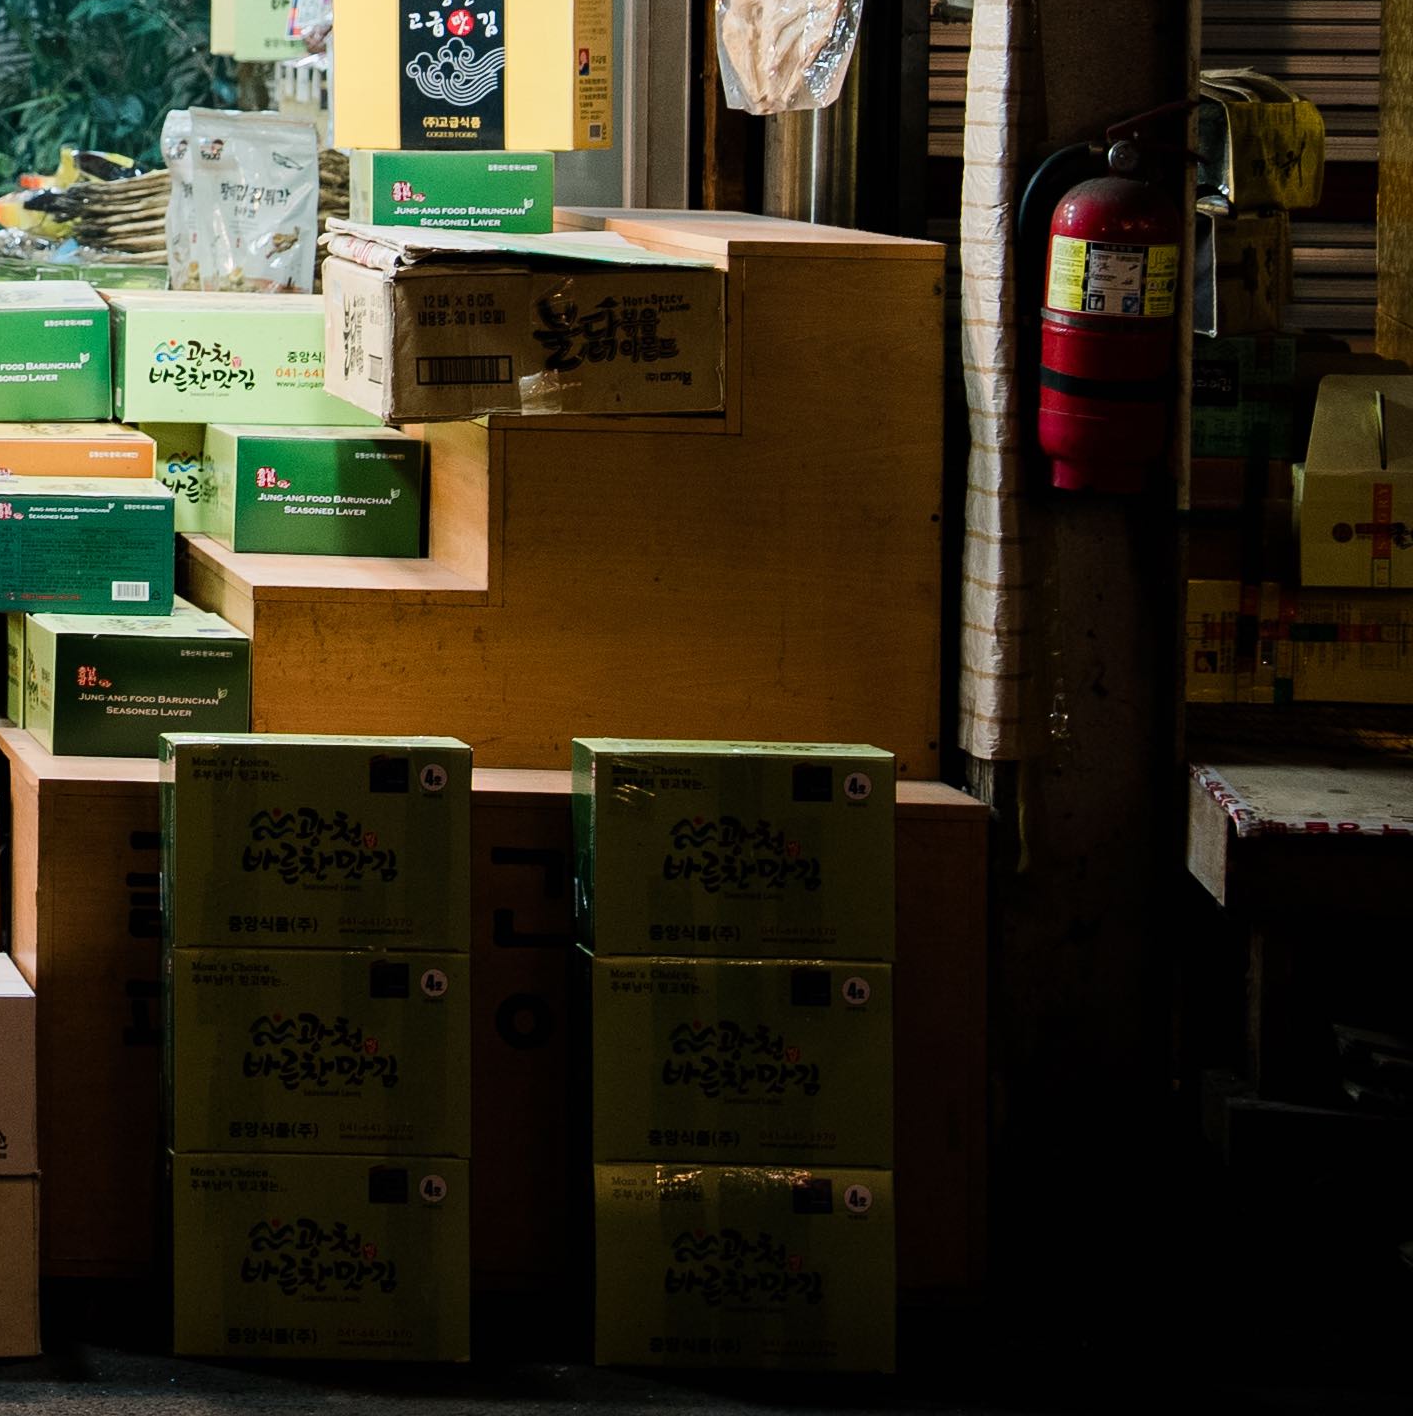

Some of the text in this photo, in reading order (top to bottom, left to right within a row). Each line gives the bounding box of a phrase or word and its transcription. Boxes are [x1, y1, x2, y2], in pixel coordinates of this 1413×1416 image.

[187, 340, 232, 366] 광천
[149, 366, 256, 392] 바른찬맛김
[335, 506, 367, 516] LAVER
[77, 693, 219, 706] JUNG-ANG FOOD BARUNCHAN
[105, 705, 192, 718] SEASONED LAVER
